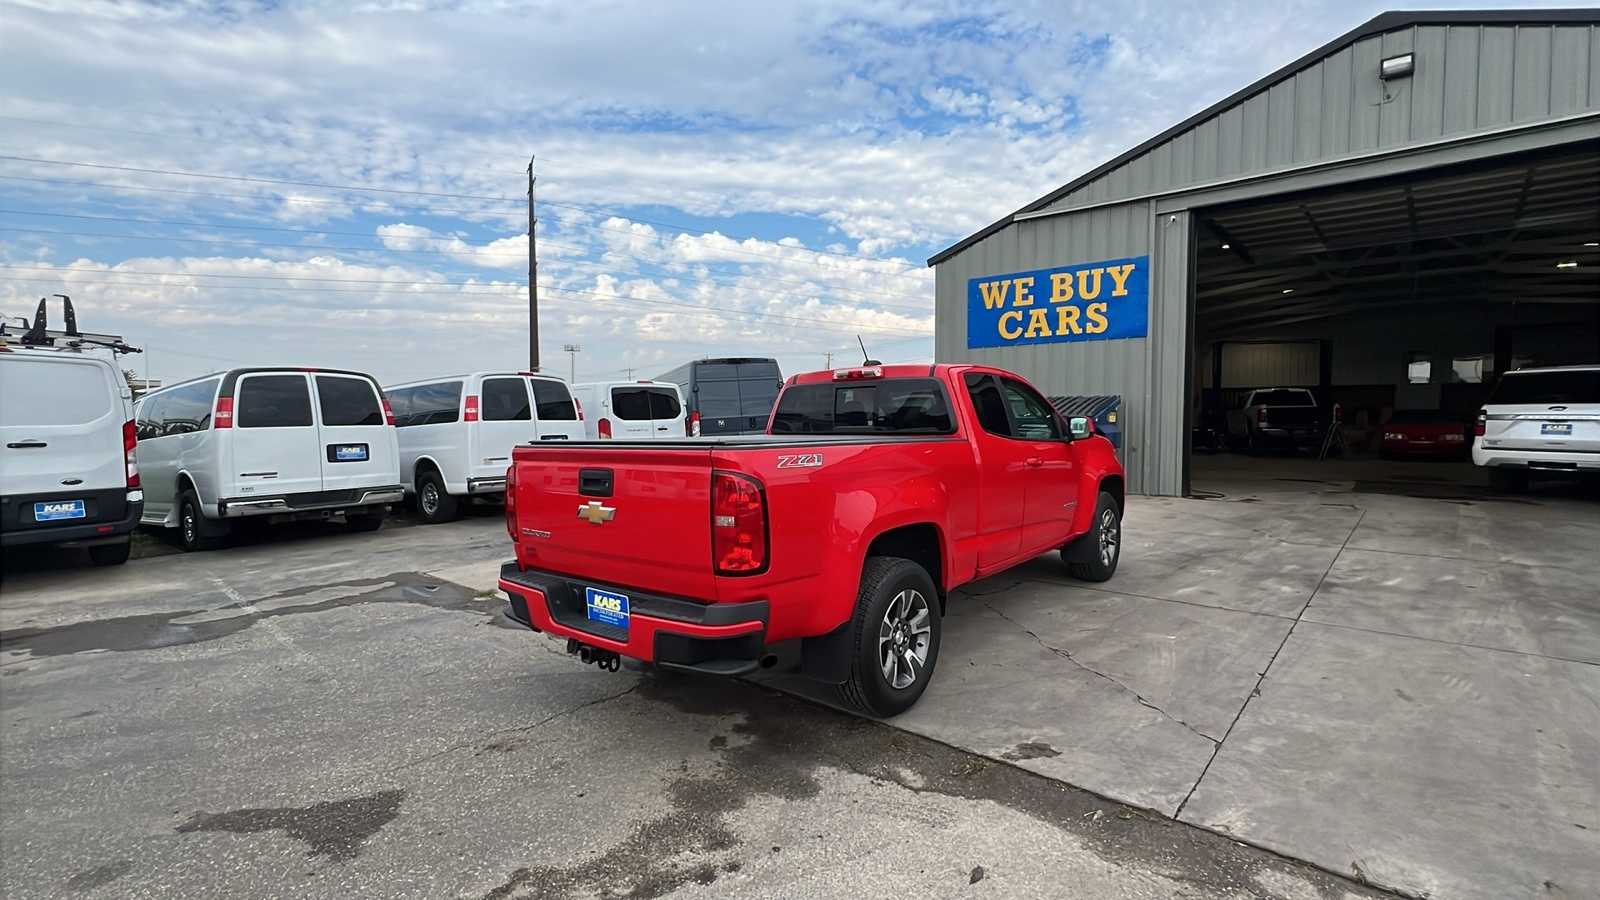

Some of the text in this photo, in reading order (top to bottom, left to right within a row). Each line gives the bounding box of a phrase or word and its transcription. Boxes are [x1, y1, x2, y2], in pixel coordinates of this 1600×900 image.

[979, 264, 1135, 310] WE BUY
[998, 302, 1108, 340] CARS
[777, 453, 822, 469] Z71
[44, 503, 76, 513] KARS
[594, 594, 621, 612] KARS
